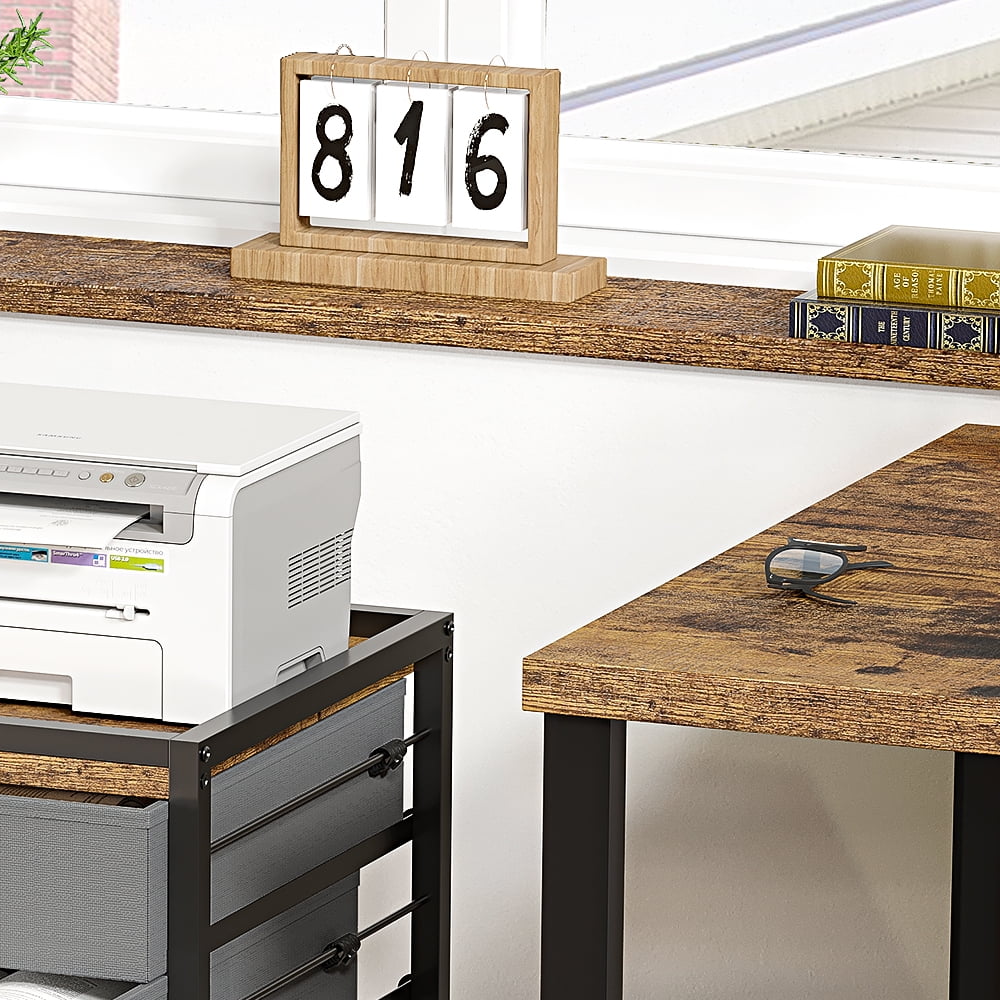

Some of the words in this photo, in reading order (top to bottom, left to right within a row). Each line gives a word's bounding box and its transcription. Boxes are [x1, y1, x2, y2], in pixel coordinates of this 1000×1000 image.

[311, 102, 354, 202] 8
[393, 101, 424, 197] 1
[464, 112, 510, 211] 6
[893, 272, 901, 290] AGE
[902, 276, 910, 288] OF
[877, 320, 886, 333] THE
[890, 310, 898, 345] NINETEENTH
[902, 315, 911, 341] CENTURY
